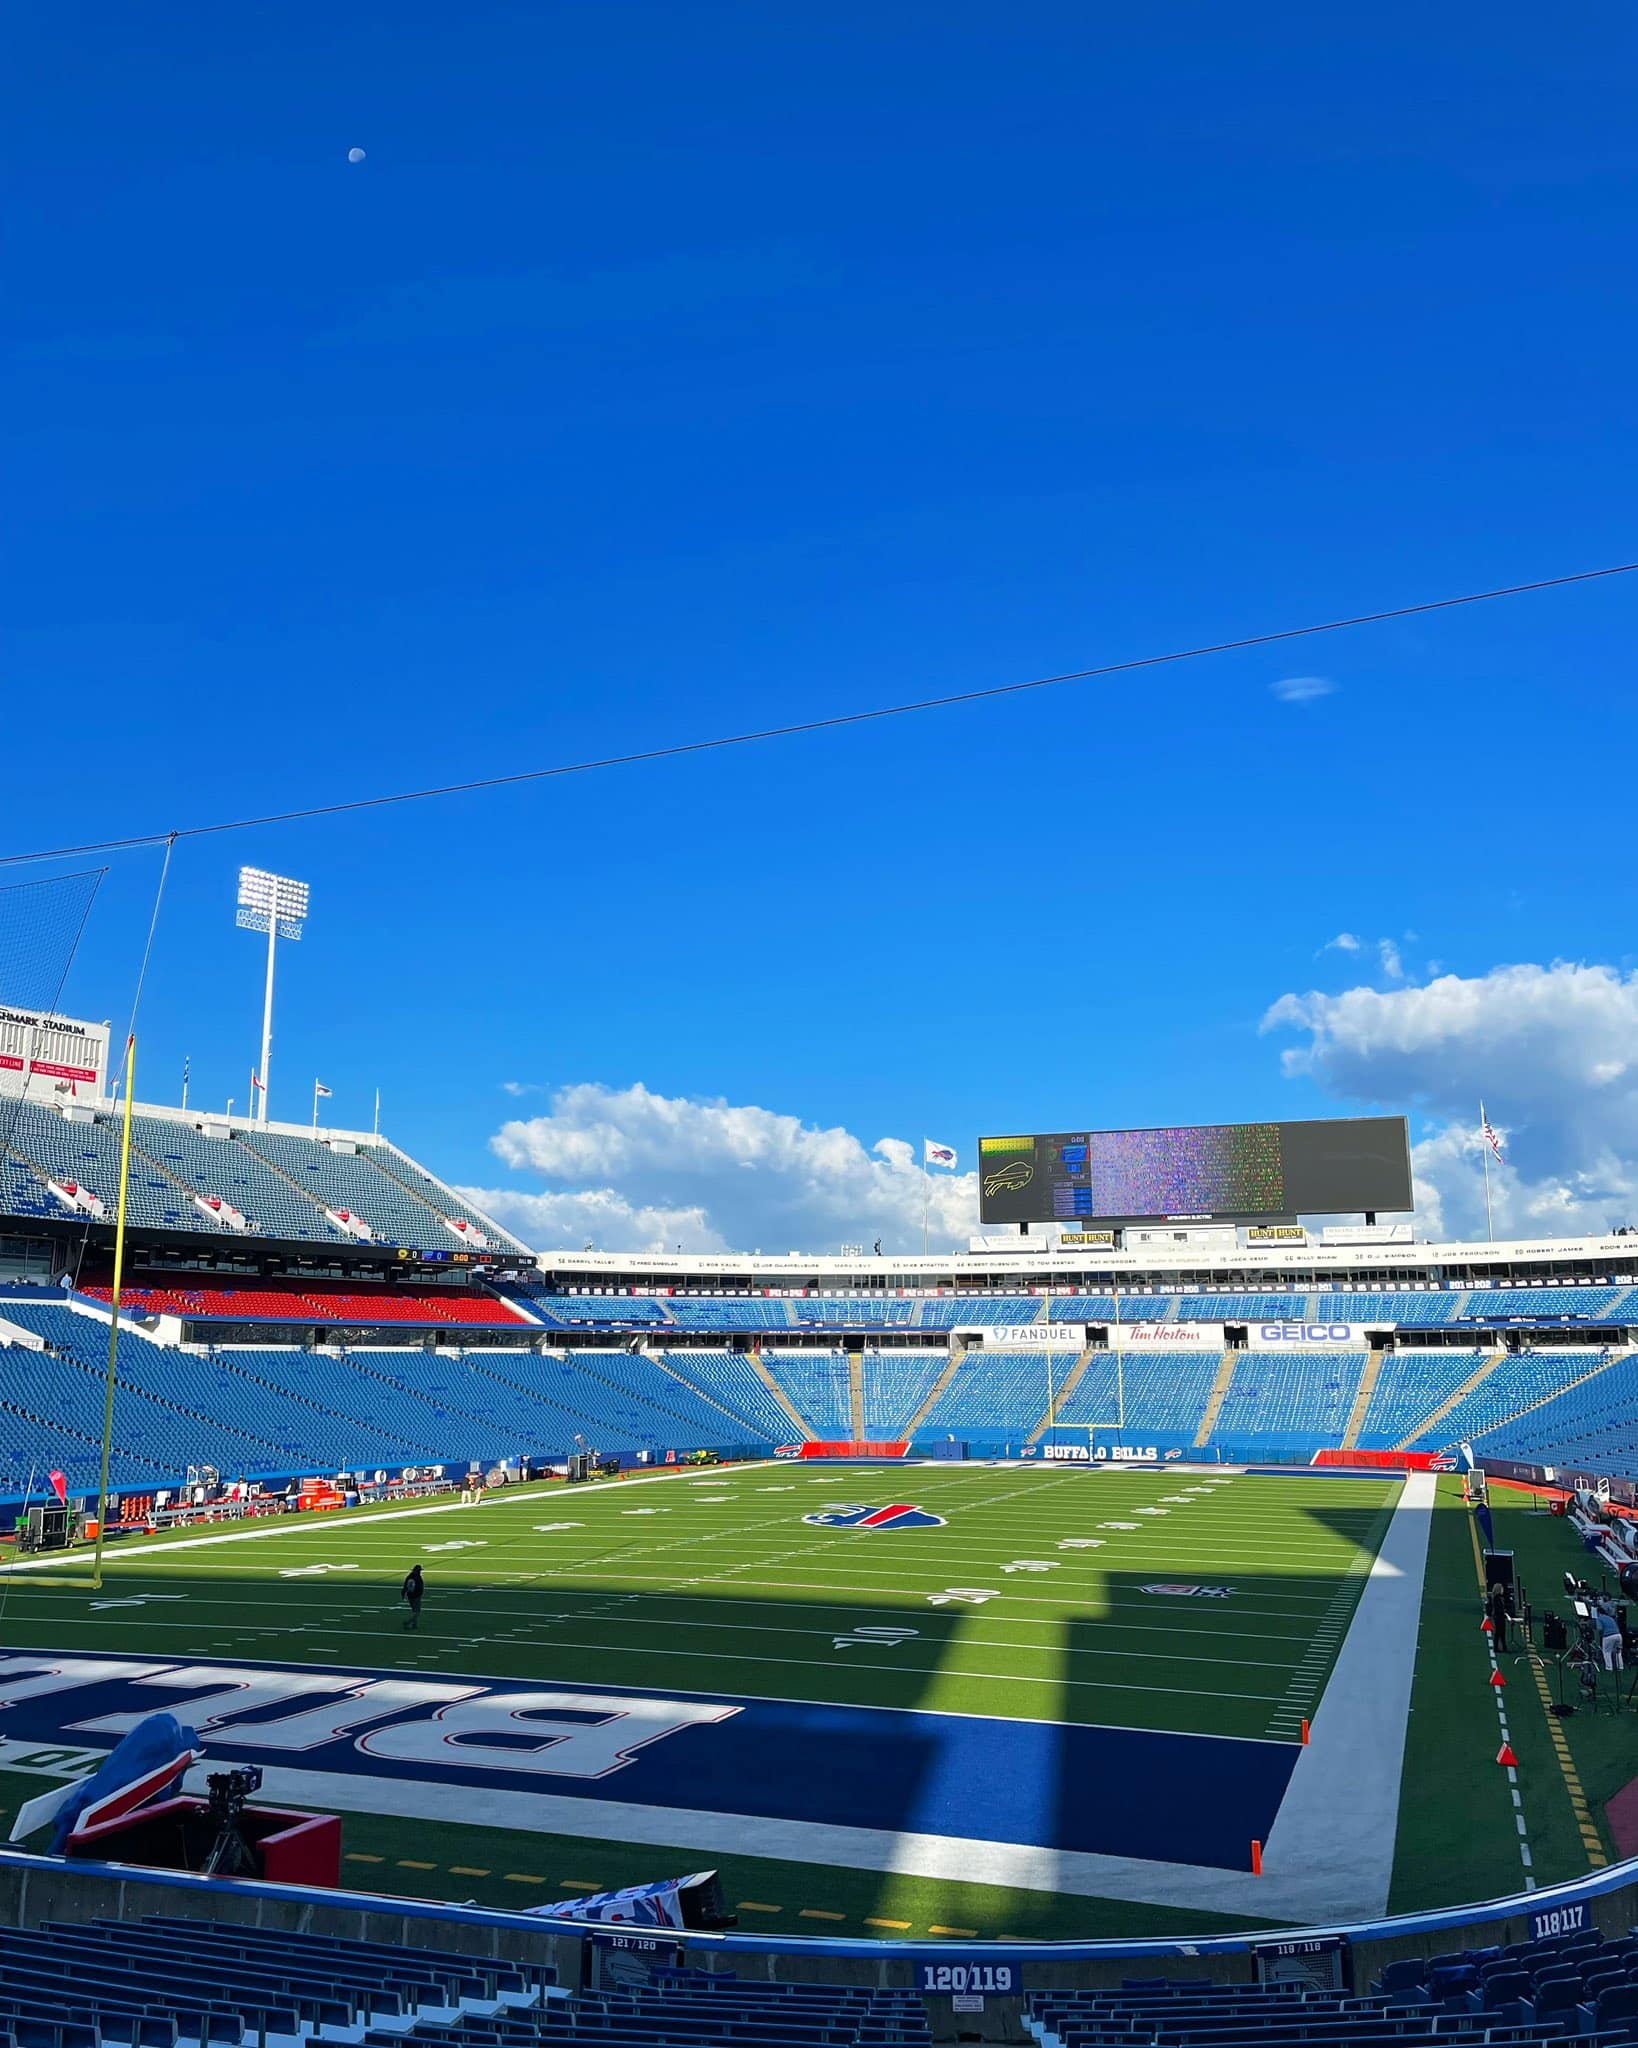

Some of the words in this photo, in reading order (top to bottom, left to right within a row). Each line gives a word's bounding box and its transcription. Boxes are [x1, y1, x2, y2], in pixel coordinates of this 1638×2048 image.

[42, 1020, 85, 1035] STADIUM
[1063, 1234, 1084, 1242] HUNT
[1088, 1233, 1109, 1241] HUNT
[1251, 1229, 1273, 1237] HUNT
[1278, 1229, 1301, 1237] HUNT
[1012, 1328, 1076, 1340] FANDUEL
[1129, 1326, 1151, 1341] Tim
[1152, 1326, 1200, 1341] Hortons
[1261, 1325, 1351, 1341] GEICO
[1112, 1446, 1158, 1460] BILLS
[1535, 1905, 1583, 1938] 118/117
[612, 1937, 629, 1948] 121
[638, 1939, 656, 1950] 120
[924, 1962, 1012, 1995] 120/119
